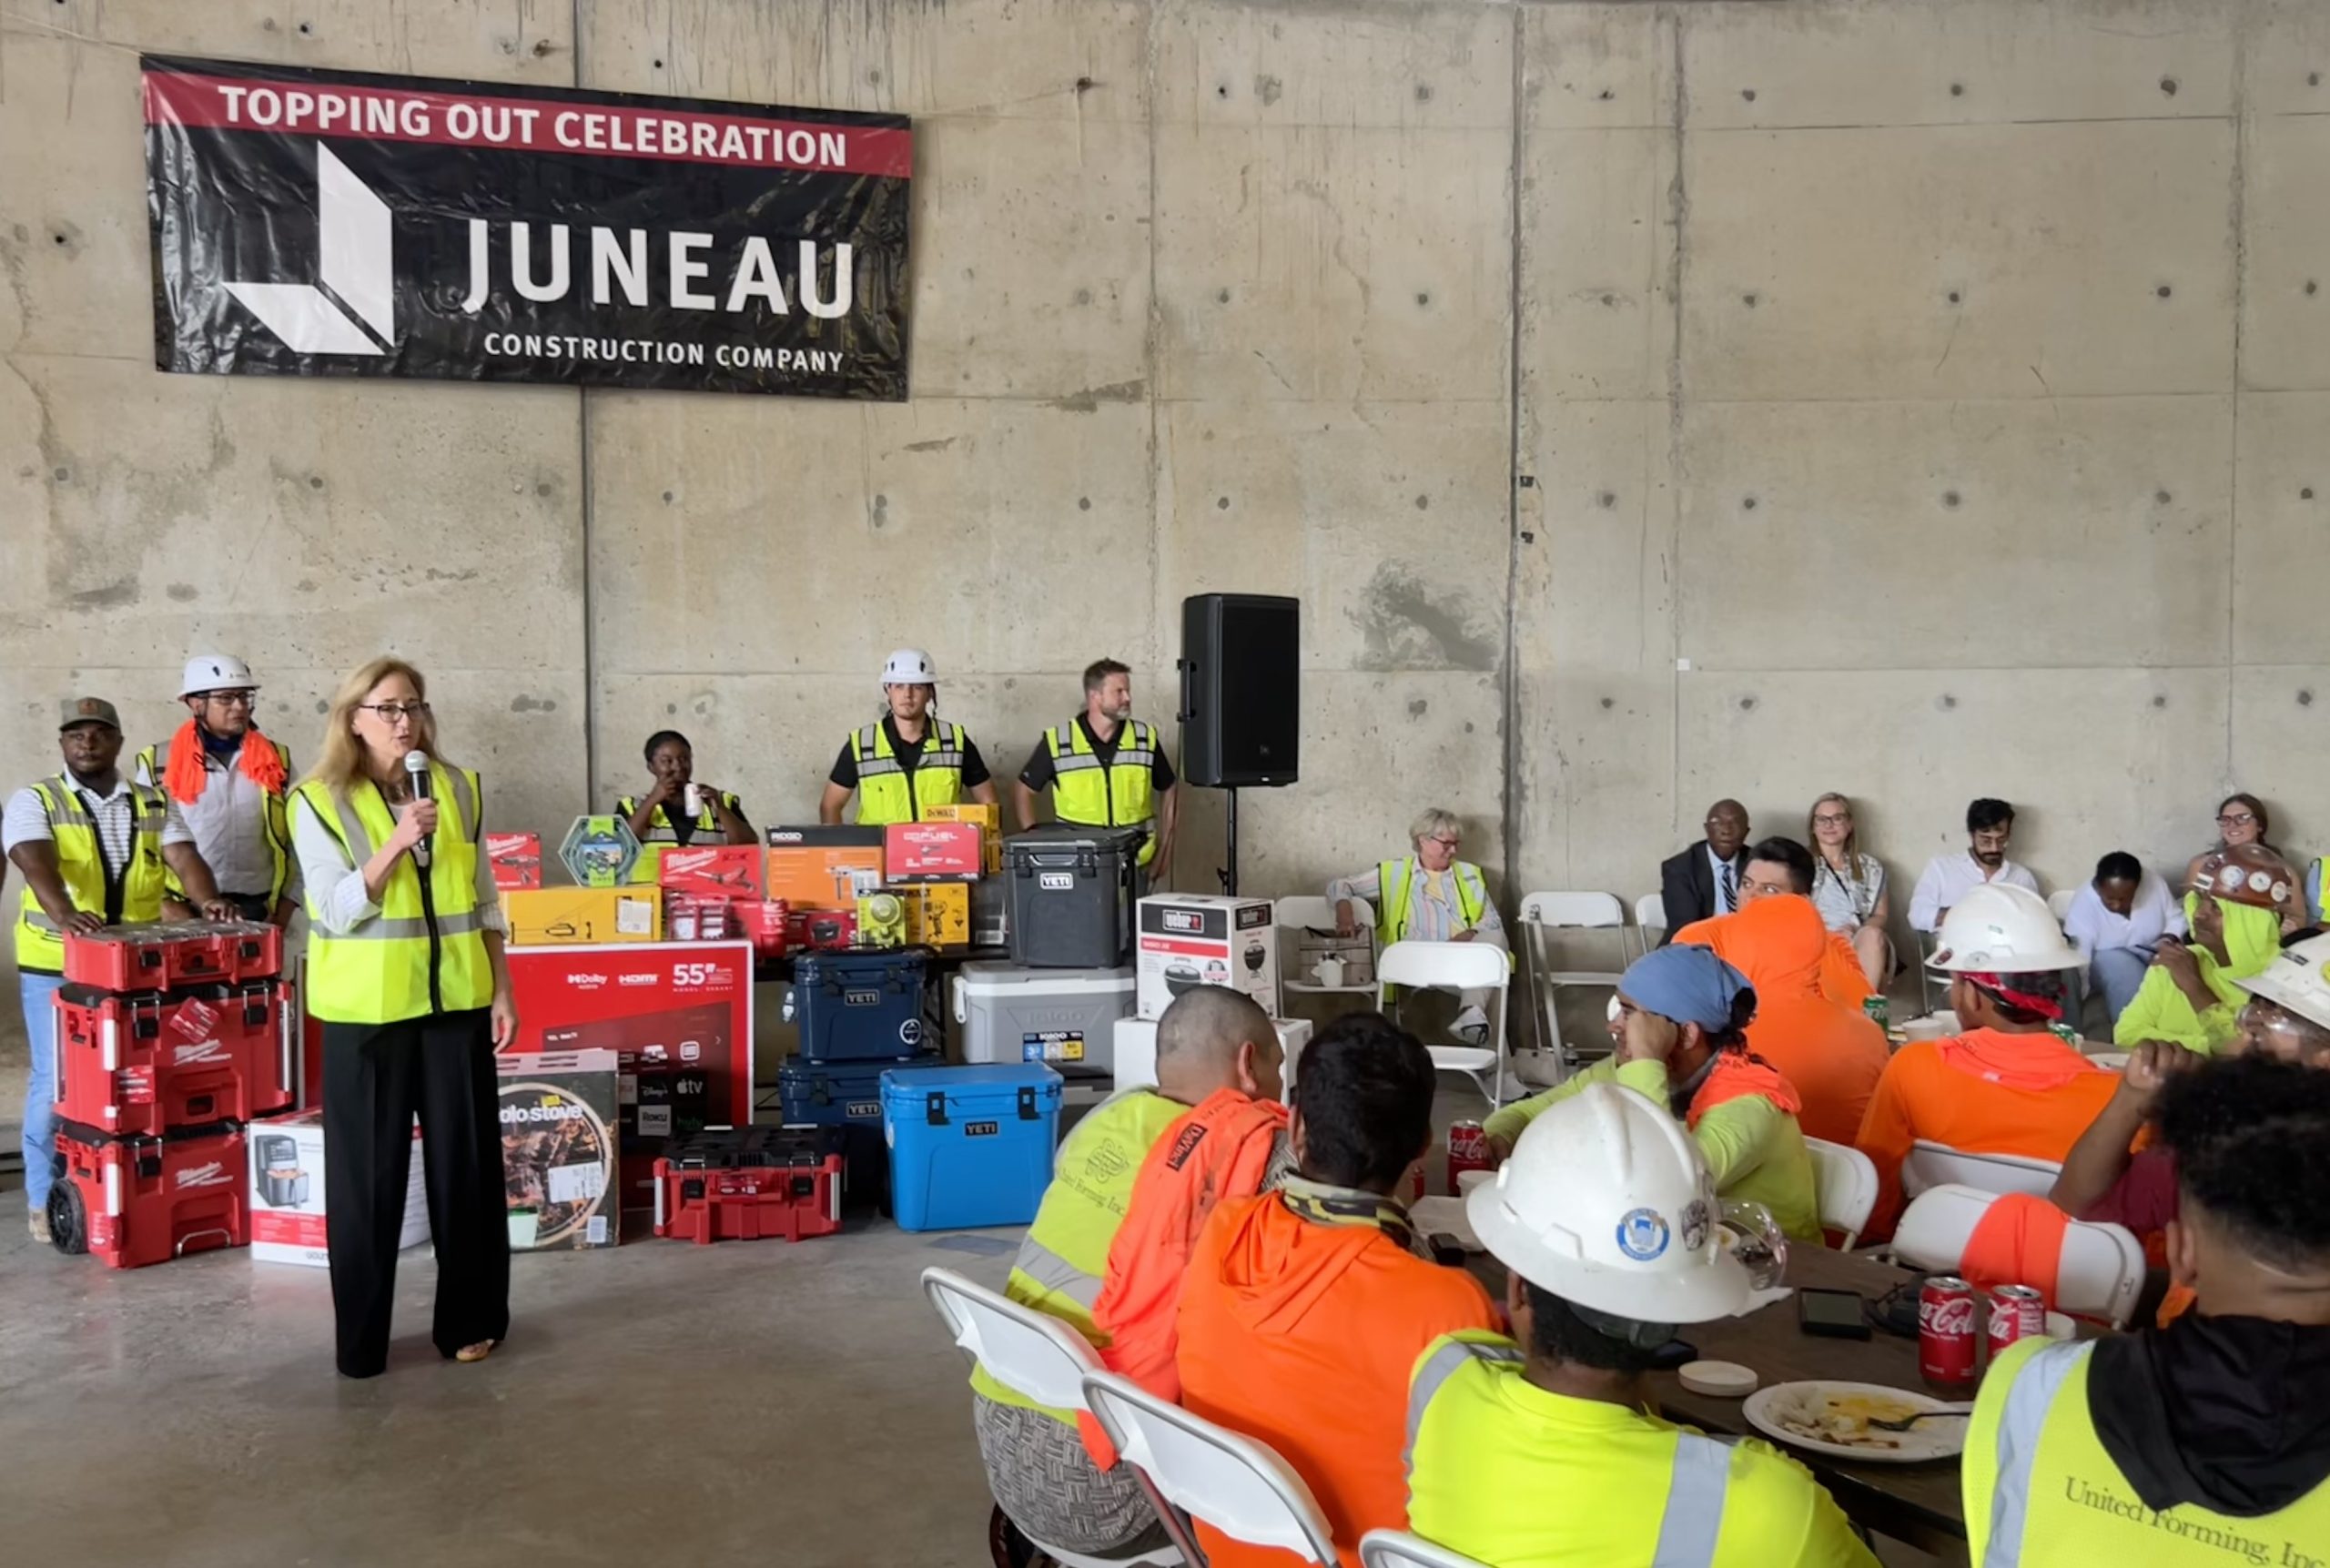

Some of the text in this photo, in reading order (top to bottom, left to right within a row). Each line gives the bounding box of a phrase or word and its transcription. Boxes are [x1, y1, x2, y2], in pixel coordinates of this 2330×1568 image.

[218, 84, 847, 167] TOPPING OUT CELEBRATION
[461, 217, 854, 320] JUNEAU
[482, 331, 845, 373] CONSTRUCTION COMPANY
[1042, 875, 1069, 887] YETI
[847, 993, 876, 1003] YETI
[499, 1104, 583, 1124] olo stove
[848, 1105, 878, 1116] YETI
[967, 1124, 997, 1135] YETI
[2064, 1476, 2143, 1522] United
